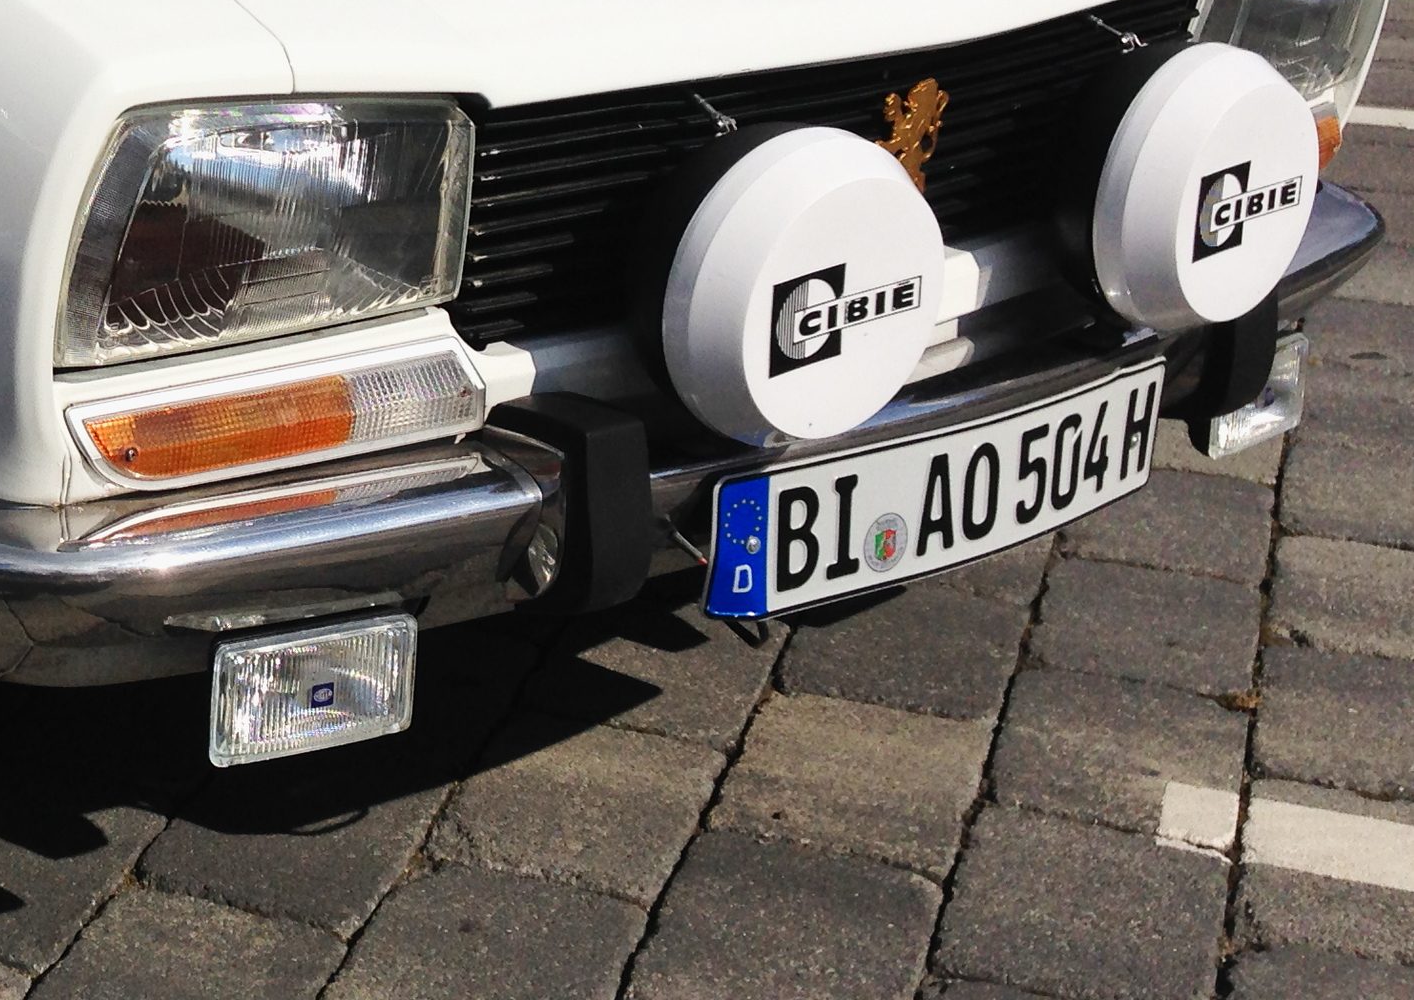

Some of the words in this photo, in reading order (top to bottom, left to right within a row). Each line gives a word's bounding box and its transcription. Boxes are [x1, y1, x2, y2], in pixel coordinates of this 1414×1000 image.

[776, 474, 860, 593] BI
[915, 442, 1000, 557] AO
[732, 564, 752, 593] D
